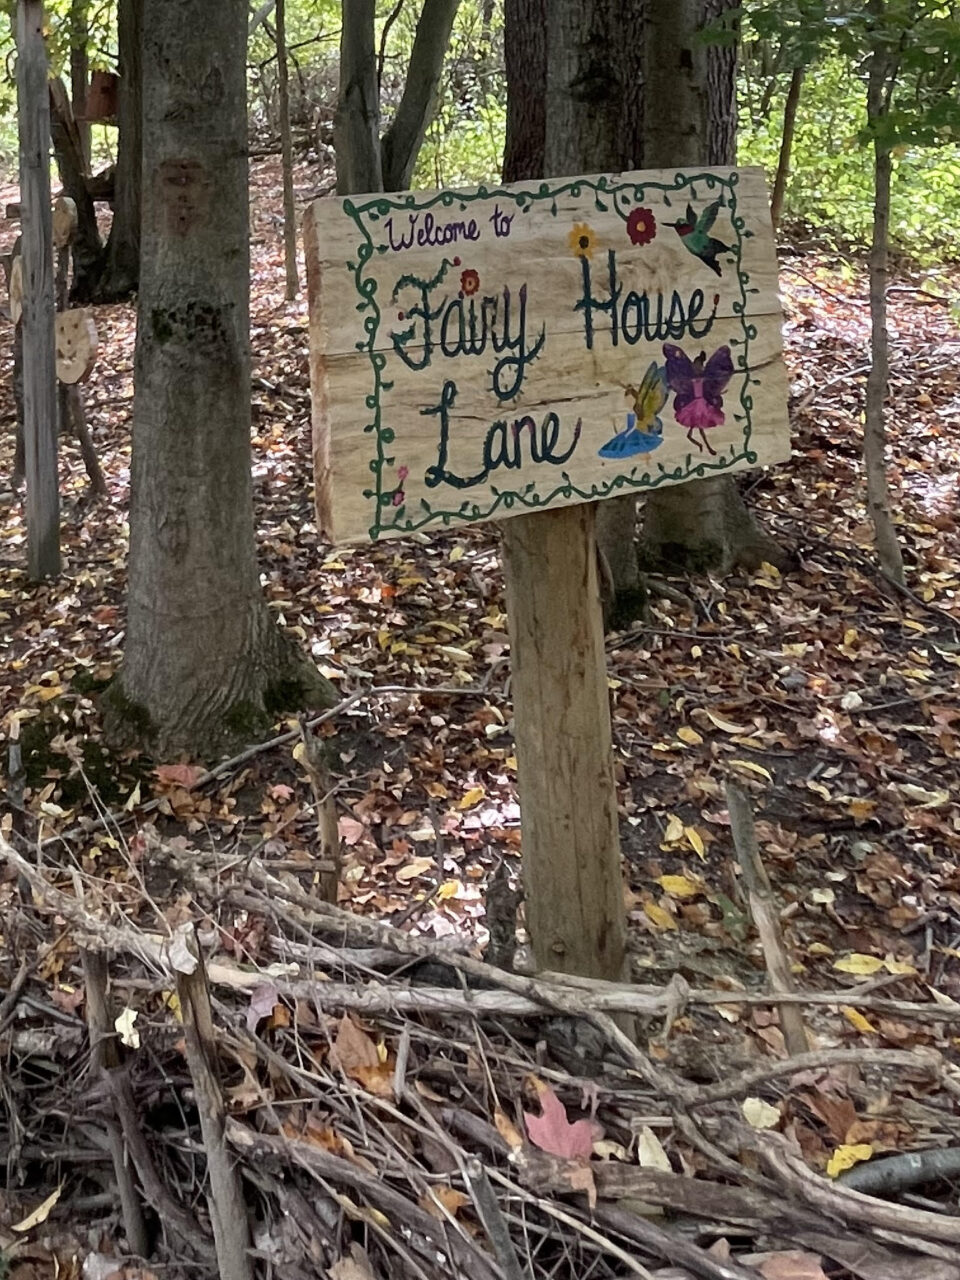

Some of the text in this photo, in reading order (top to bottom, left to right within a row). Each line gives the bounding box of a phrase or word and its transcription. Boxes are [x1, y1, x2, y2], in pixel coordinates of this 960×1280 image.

[384, 204, 515, 252] Welcome to
[391, 249, 719, 402] Fairy House
[420, 380, 582, 489] Lane
